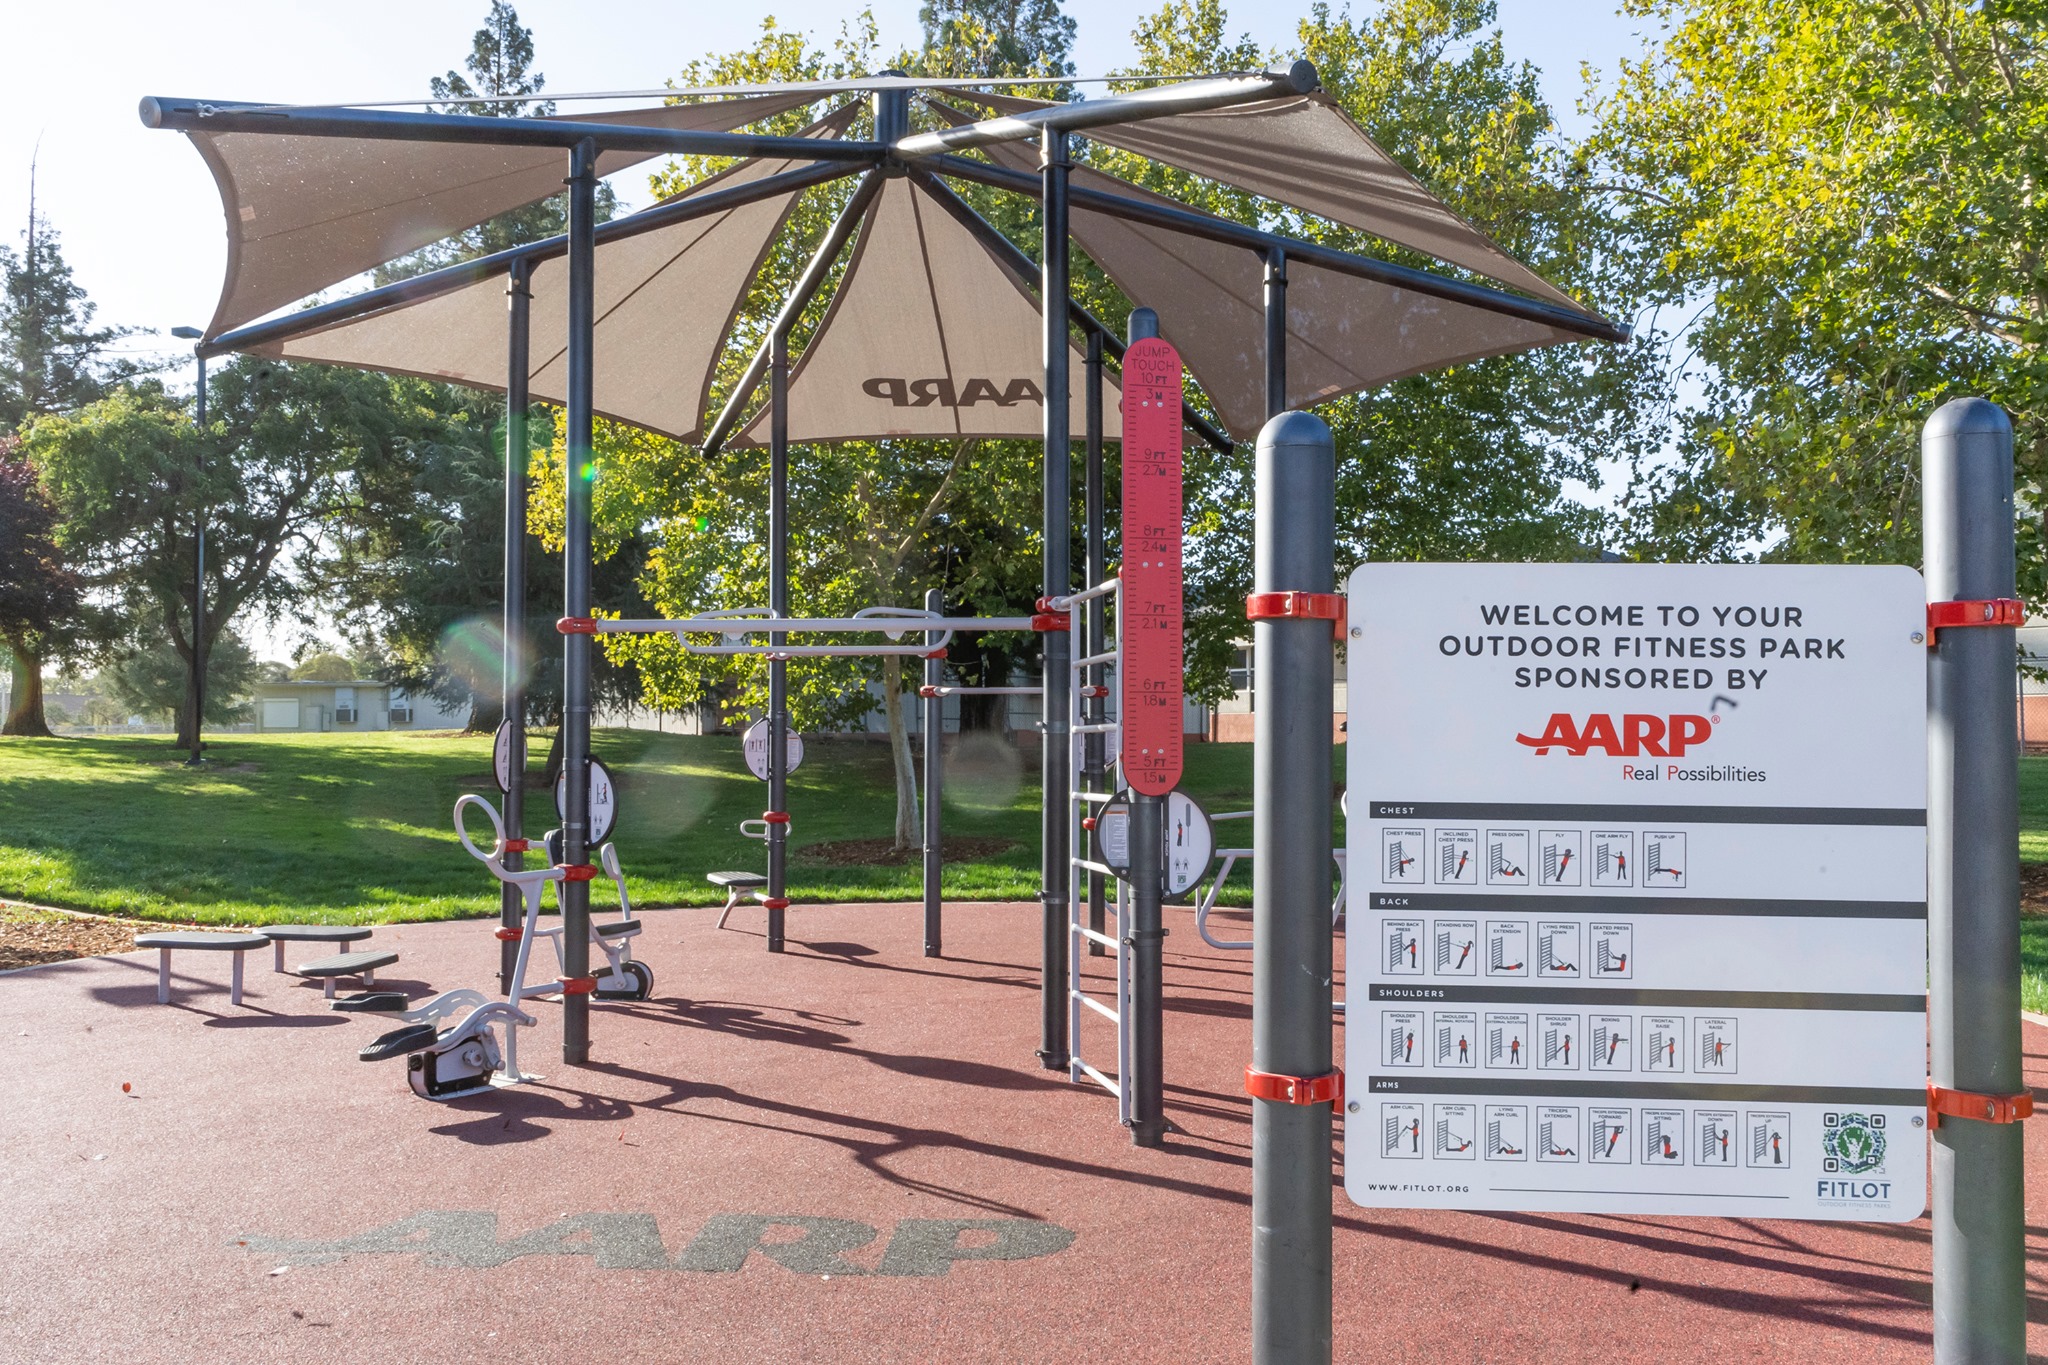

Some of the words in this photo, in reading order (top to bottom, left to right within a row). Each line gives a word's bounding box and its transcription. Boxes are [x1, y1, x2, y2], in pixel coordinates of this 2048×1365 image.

[1135, 346, 1170, 358] JUMP
[1132, 358, 1174, 371] TOUCH
[1480, 604, 1644, 626] WELCOME
[1657, 606, 1700, 627] TO
[1712, 606, 1804, 628] YOUR
[1439, 636, 1601, 658] OUTDOOR
[1614, 637, 1746, 659] FITNESS
[1759, 638, 1845, 660] PARK
[1514, 667, 1714, 690] SPONSORED
[1727, 669, 1768, 690] BY
[1622, 765, 1659, 781] Real
[1667, 766, 1766, 783] Possibilities
[1380, 806, 1415, 814] CHEST
[1368, 1184, 1469, 1192] WWW.FITLOT.ORG
[1818, 1181, 1891, 1198] FITLOT
[226, 1209, 1077, 1277] AARP
